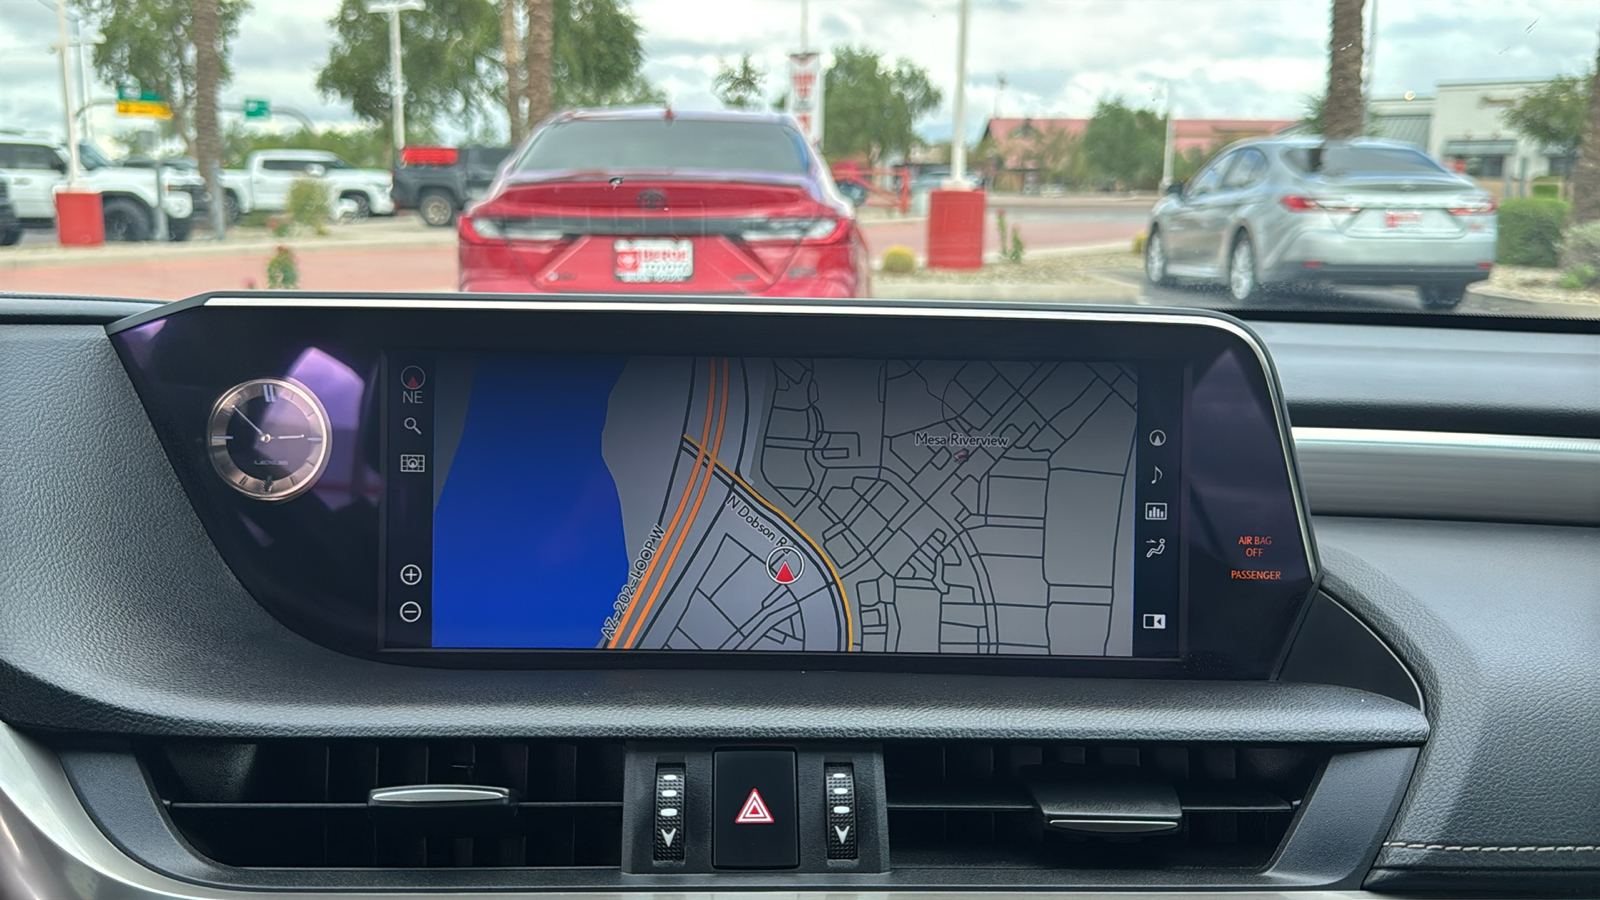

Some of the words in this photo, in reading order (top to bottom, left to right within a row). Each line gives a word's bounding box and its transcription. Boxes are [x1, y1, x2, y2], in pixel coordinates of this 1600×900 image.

[402, 390, 423, 404] NE
[915, 432, 947, 446] Mesa
[950, 432, 1009, 447] Riverview
[726, 494, 741, 510] N
[737, 504, 776, 542] Dobson
[649, 524, 665, 540] W
[1238, 535, 1253, 546] AIR
[1254, 535, 1273, 546] BAG
[1245, 547, 1264, 557] OFF
[1230, 569, 1282, 581] PASSENGER
